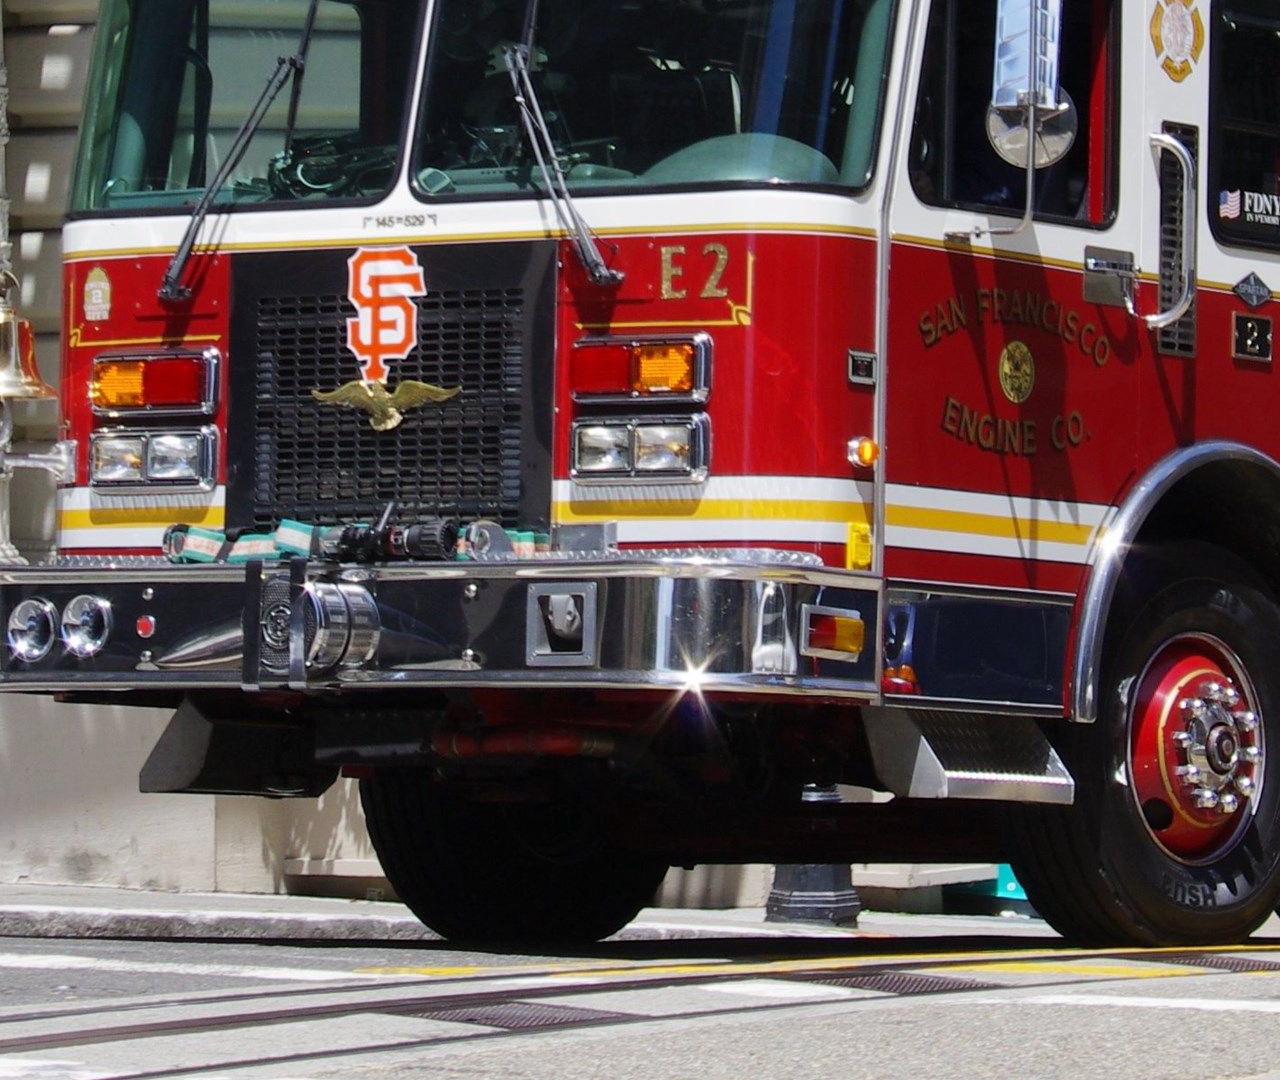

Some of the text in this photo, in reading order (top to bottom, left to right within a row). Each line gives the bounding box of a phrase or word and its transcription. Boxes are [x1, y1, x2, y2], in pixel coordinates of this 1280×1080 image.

[660, 242, 729, 300] E 2
[347, 245, 426, 382] SF
[919, 287, 1110, 367] SAN FRANCISCO
[1246, 321, 1260, 353] 2
[941, 396, 1092, 459] ENGINE CO.
